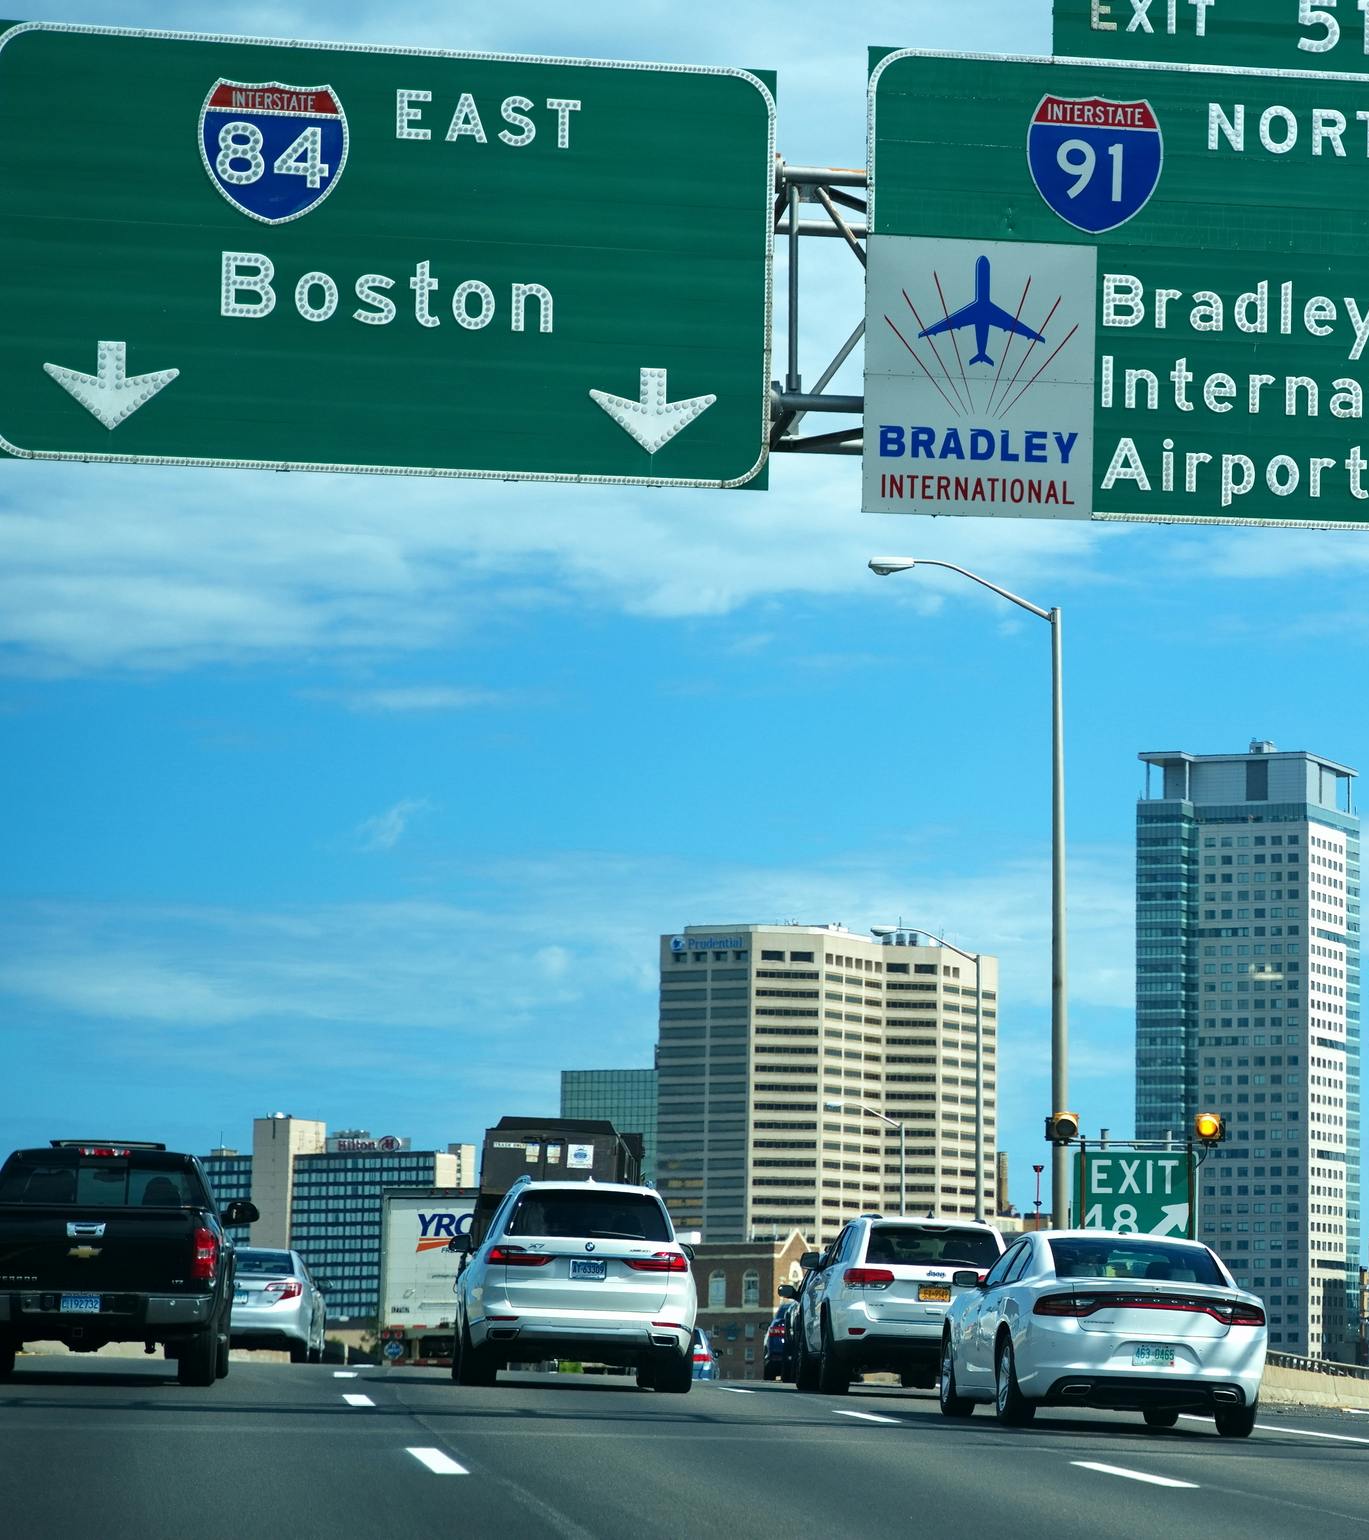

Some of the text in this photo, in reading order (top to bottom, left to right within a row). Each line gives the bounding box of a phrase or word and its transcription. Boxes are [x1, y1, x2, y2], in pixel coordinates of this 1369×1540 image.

[1090, 0, 1214, 36] EXIT
[231, 91, 316, 113] INTERSTATE
[396, 89, 581, 148] EAST
[1047, 103, 1143, 126] INTERSTATE
[215, 122, 329, 189] 84
[1057, 139, 1123, 201] 91
[221, 251, 553, 332] Boston
[880, 425, 1078, 463] BRADLEY
[882, 474, 1074, 504] INTERNATIONAL
[1101, 438, 1369, 506] Airport
[688, 936, 743, 949] Prudential
[338, 1139, 376, 1151] Hilton
[1092, 1160, 1178, 1194] EXIT
[418, 1213, 474, 1236] YRC
